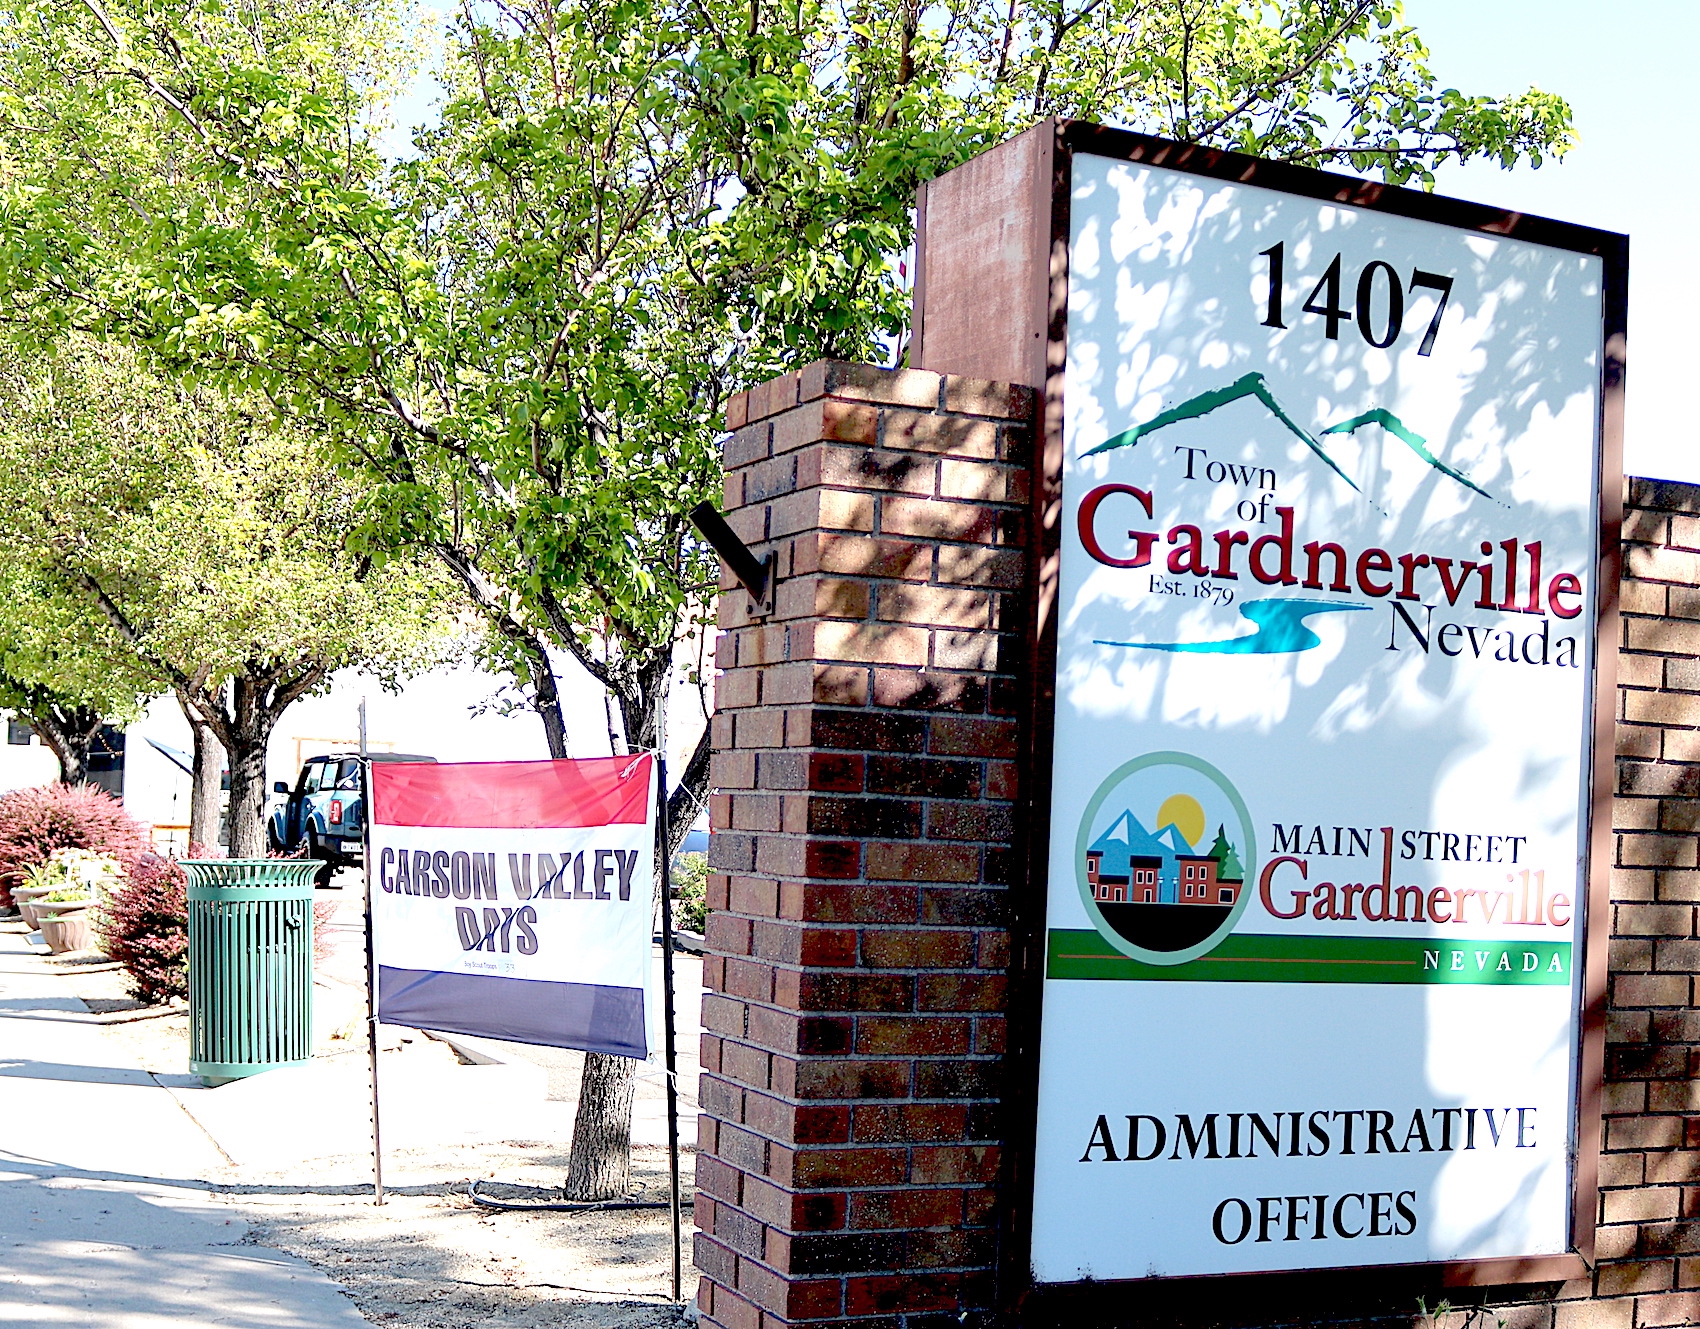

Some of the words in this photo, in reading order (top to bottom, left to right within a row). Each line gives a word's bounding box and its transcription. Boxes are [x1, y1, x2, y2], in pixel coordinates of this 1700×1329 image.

[1258, 240, 1454, 357] 1407
[1174, 445, 1277, 491] Town
[1237, 494, 1272, 524] of
[1077, 483, 1583, 619] Gardnerville
[1148, 574, 1186, 597] Est.
[1193, 580, 1235, 607] 1879
[1385, 600, 1580, 669] Nevada
[1271, 823, 1372, 858] MAIN
[1400, 830, 1527, 864] STREET
[380, 846, 498, 901] CARSON
[508, 849, 639, 902] VALLEY
[1259, 827, 1571, 927] Gardnerville
[455, 905, 539, 955] DAYS
[1423, 950, 1563, 973] NEVADA
[1079, 1107, 1537, 1163] ADMINISTRATIVE
[1211, 1190, 1417, 1245] OFFICES
